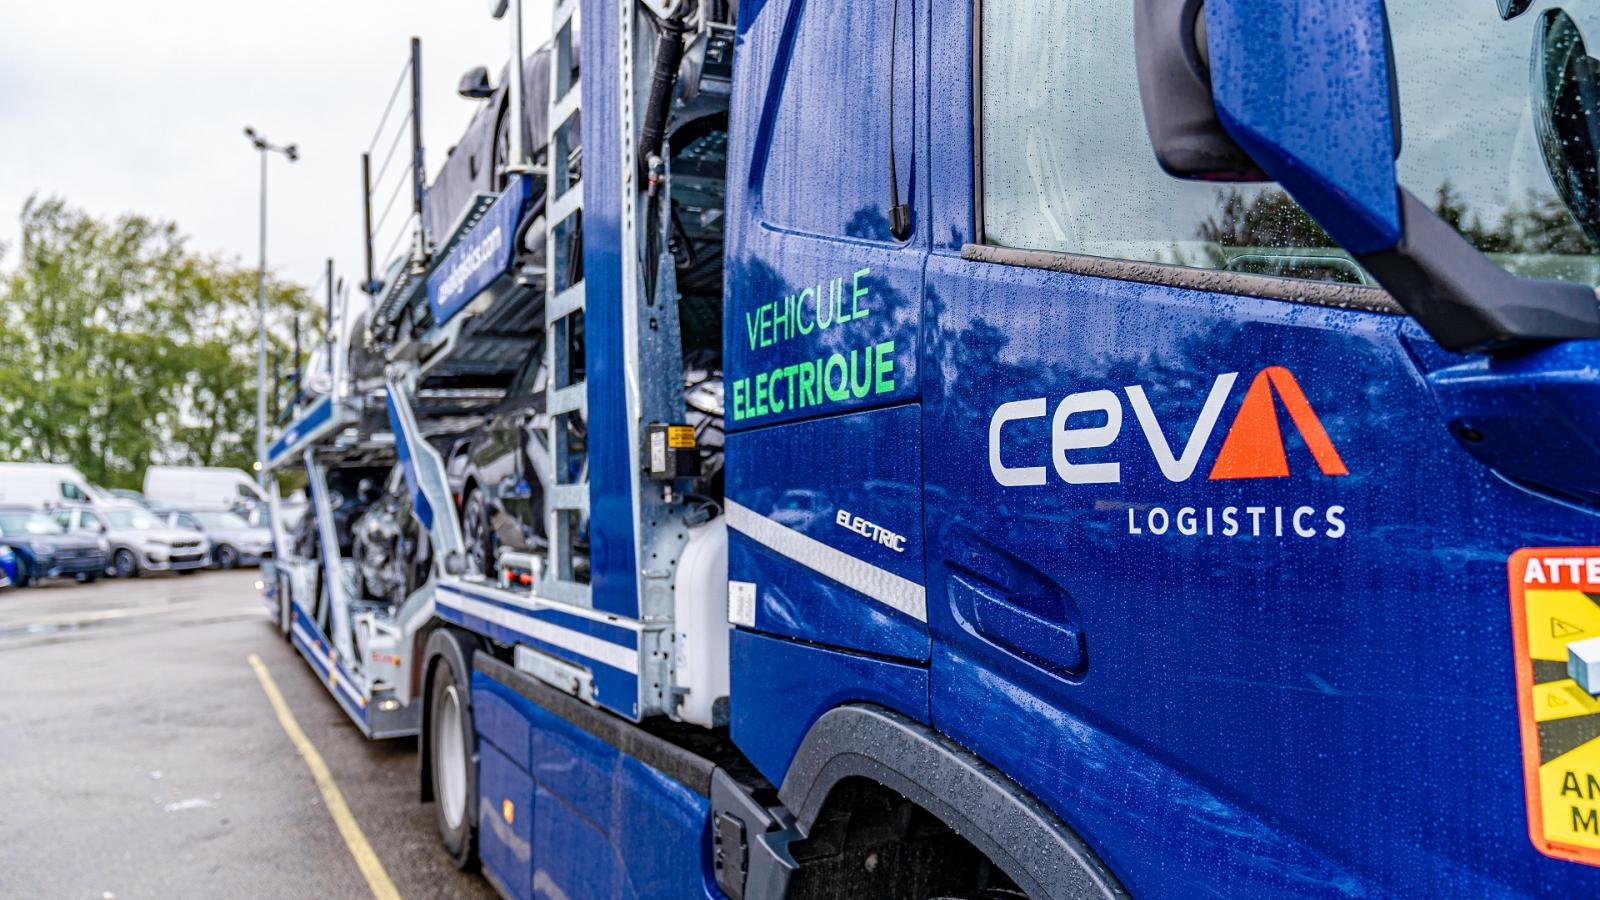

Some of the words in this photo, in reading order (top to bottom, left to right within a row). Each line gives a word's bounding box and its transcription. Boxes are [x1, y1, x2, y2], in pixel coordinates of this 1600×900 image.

[746, 268, 870, 351] VEHICULE
[733, 341, 895, 421] ELECTRIQUE
[836, 509, 907, 552] ELECTRIC
[1128, 505, 1346, 538] LOGISTICS
